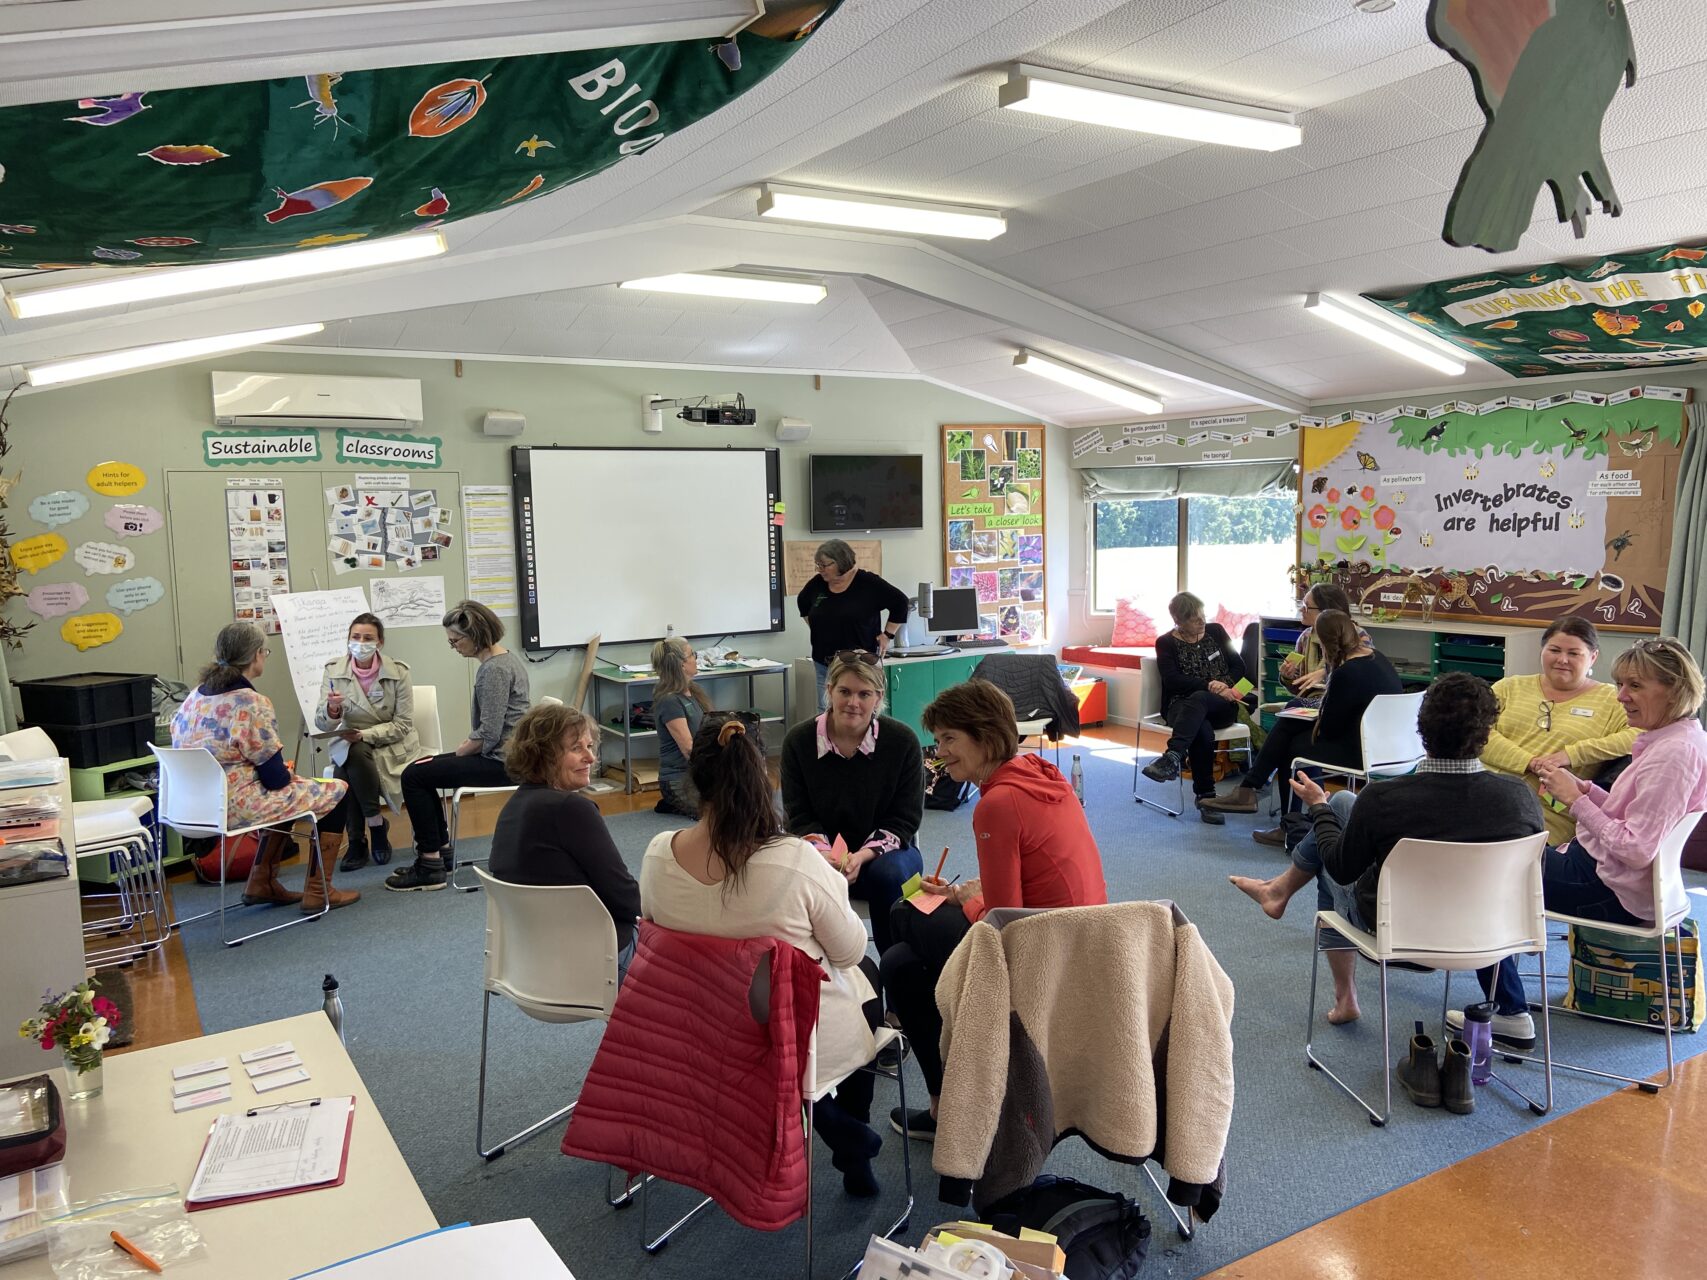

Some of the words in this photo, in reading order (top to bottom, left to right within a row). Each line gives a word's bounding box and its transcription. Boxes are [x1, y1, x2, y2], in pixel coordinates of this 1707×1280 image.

[1462, 284, 1583, 318] TURNING
[1589, 279, 1648, 303] THE
[1555, 353, 1650, 362] Making
[1657, 350, 1704, 359] the
[1199, 417, 1218, 426] special,
[1222, 415, 1246, 423] treasure!
[1144, 423, 1161, 432] protect
[1074, 430, 1099, 446] Invertebrates
[211, 438, 313, 455] Sustainable
[346, 440, 434, 460] classrooms
[1391, 475, 1422, 483] pollinators
[1611, 471, 1629, 479] food
[114, 480, 138, 488] helpers
[1435, 482, 1573, 513] Invertebrates
[951, 505, 970, 514] Let's
[974, 503, 992, 513] take
[995, 517, 1019, 526] closer
[1022, 515, 1039, 525] look
[1443, 516, 1476, 532] are
[1488, 511, 1561, 538] helpful
